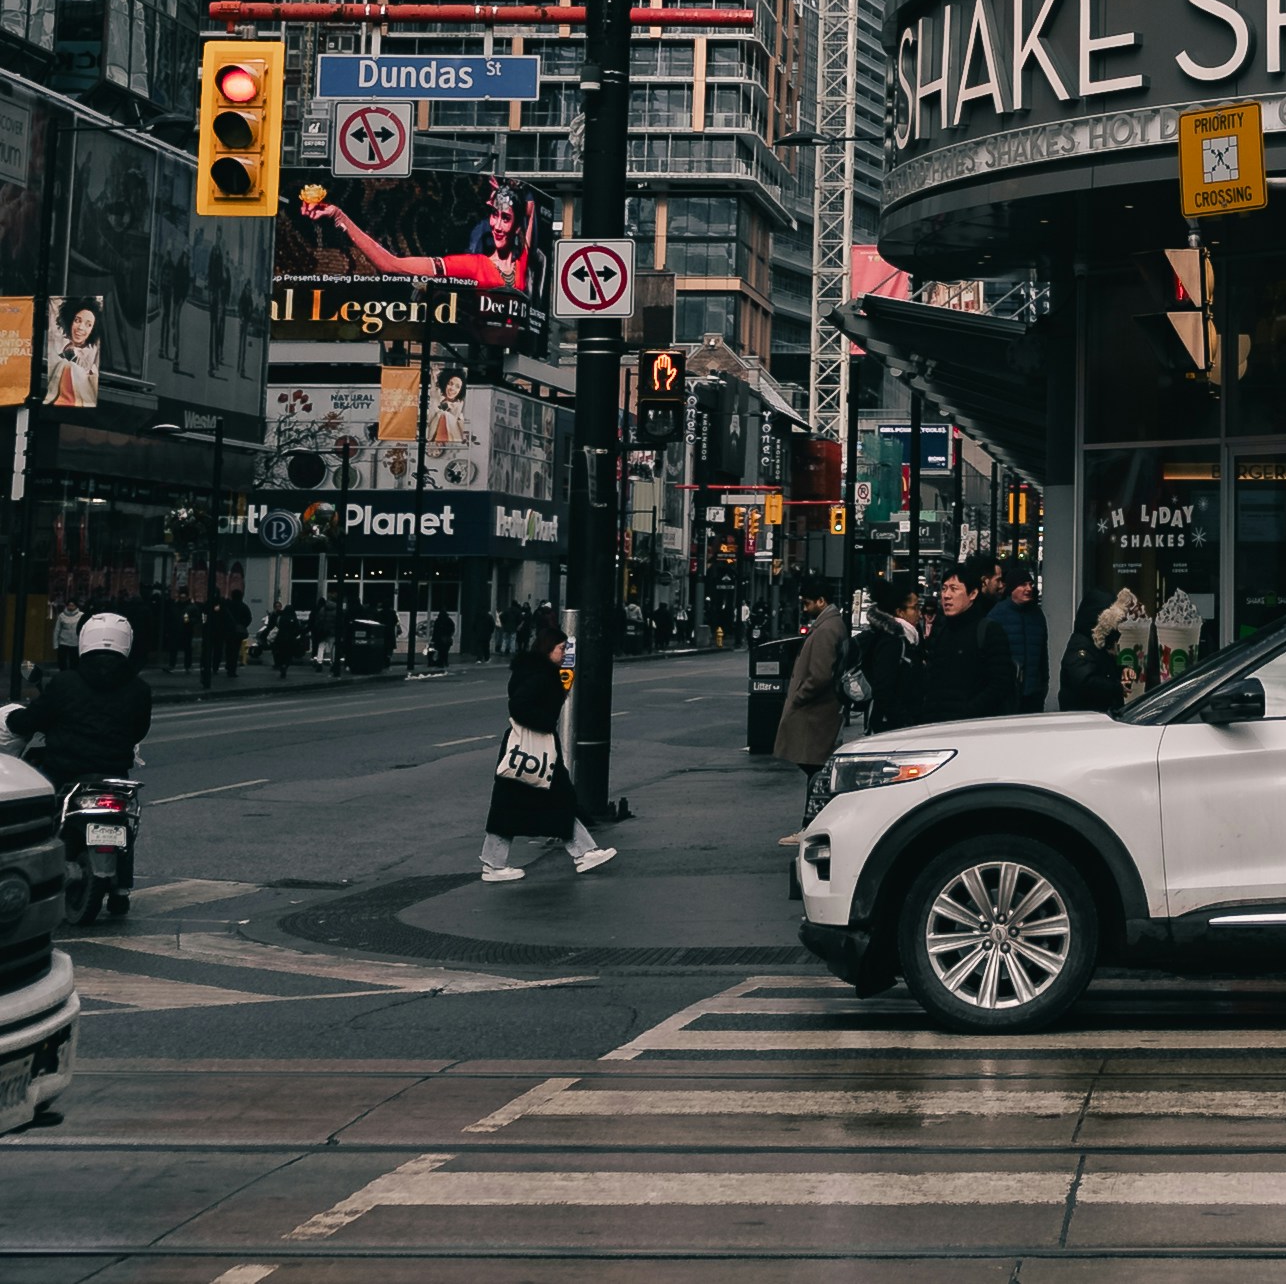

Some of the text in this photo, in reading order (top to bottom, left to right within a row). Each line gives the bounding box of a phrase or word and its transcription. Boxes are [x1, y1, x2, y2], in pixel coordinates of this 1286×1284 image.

[358, 60, 502, 91] Dundas St
[1194, 112, 1245, 135] PRIORITY
[933, 144, 976, 183] FRIES
[985, 121, 1077, 169] SHAKES
[1089, 110, 1151, 150] HOT
[1194, 185, 1253, 209] CROSSING
[283, 273, 321, 282] Presents
[353, 275, 381, 283] Dance
[382, 275, 411, 283] Drama
[412, 275, 420, 283] &
[479, 295, 505, 314] Dec
[331, 393, 375, 402] NATURAL
[333, 401, 371, 410] BEAUTY
[345, 504, 455, 535] Planet
[1111, 504, 1194, 529] HLIDAY
[1120, 534, 1185, 548] SHAKES
[753, 682, 772, 691] Litter
[509, 745, 555, 782] tpl:
